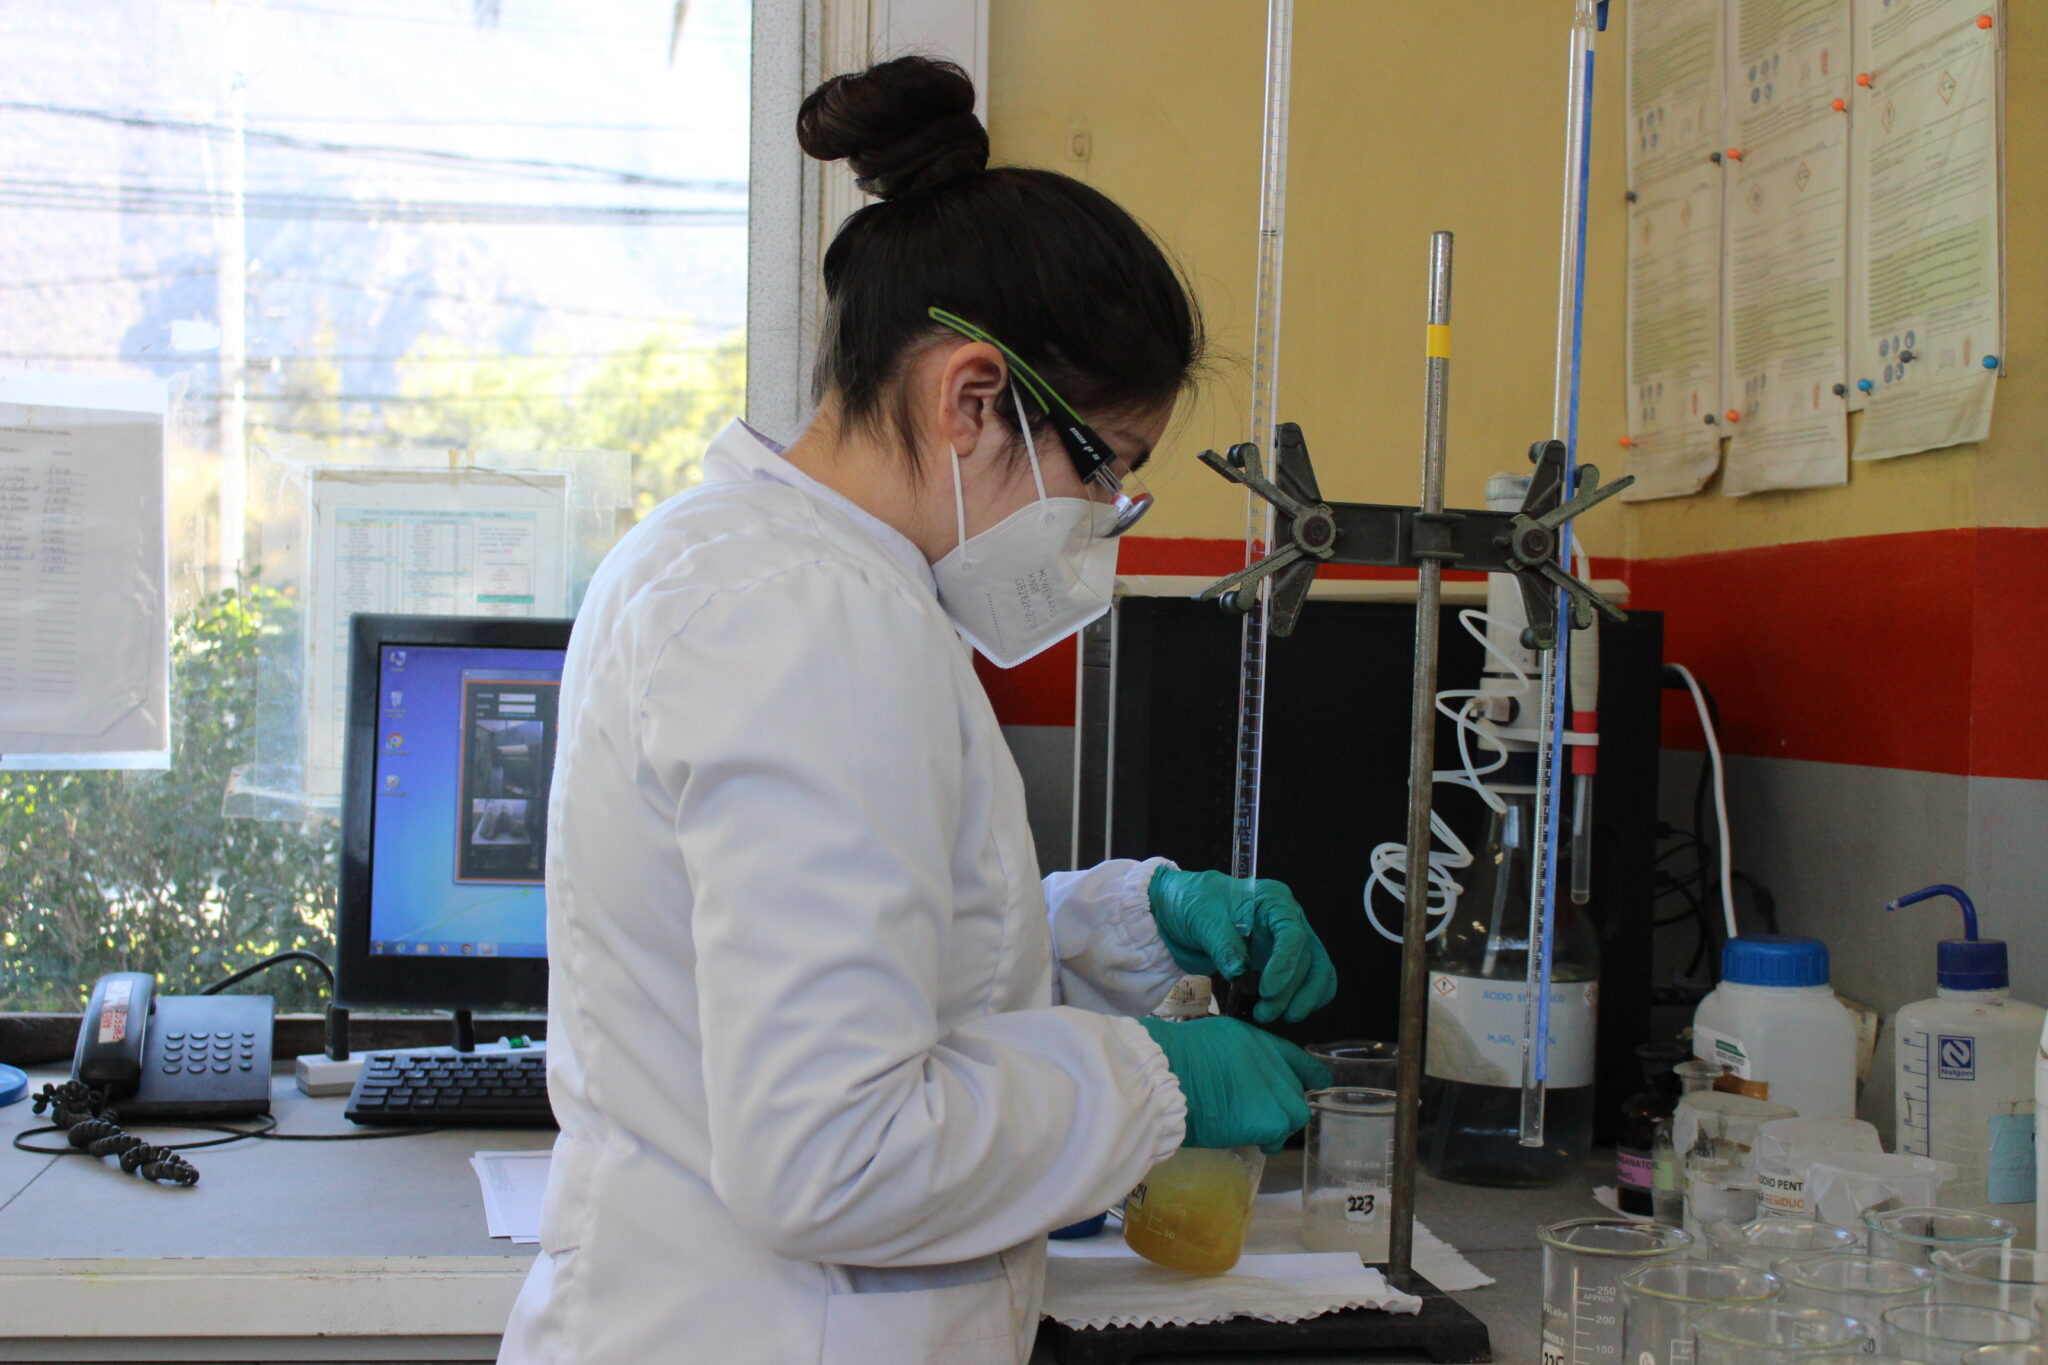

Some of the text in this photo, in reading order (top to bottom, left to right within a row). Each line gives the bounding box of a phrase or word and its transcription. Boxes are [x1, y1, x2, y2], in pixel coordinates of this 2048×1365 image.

[1347, 1194, 1375, 1215] 223
[1597, 1286, 1616, 1296] 250
[1596, 1315, 1616, 1325] 200
[1596, 1345, 1615, 1355] 150
